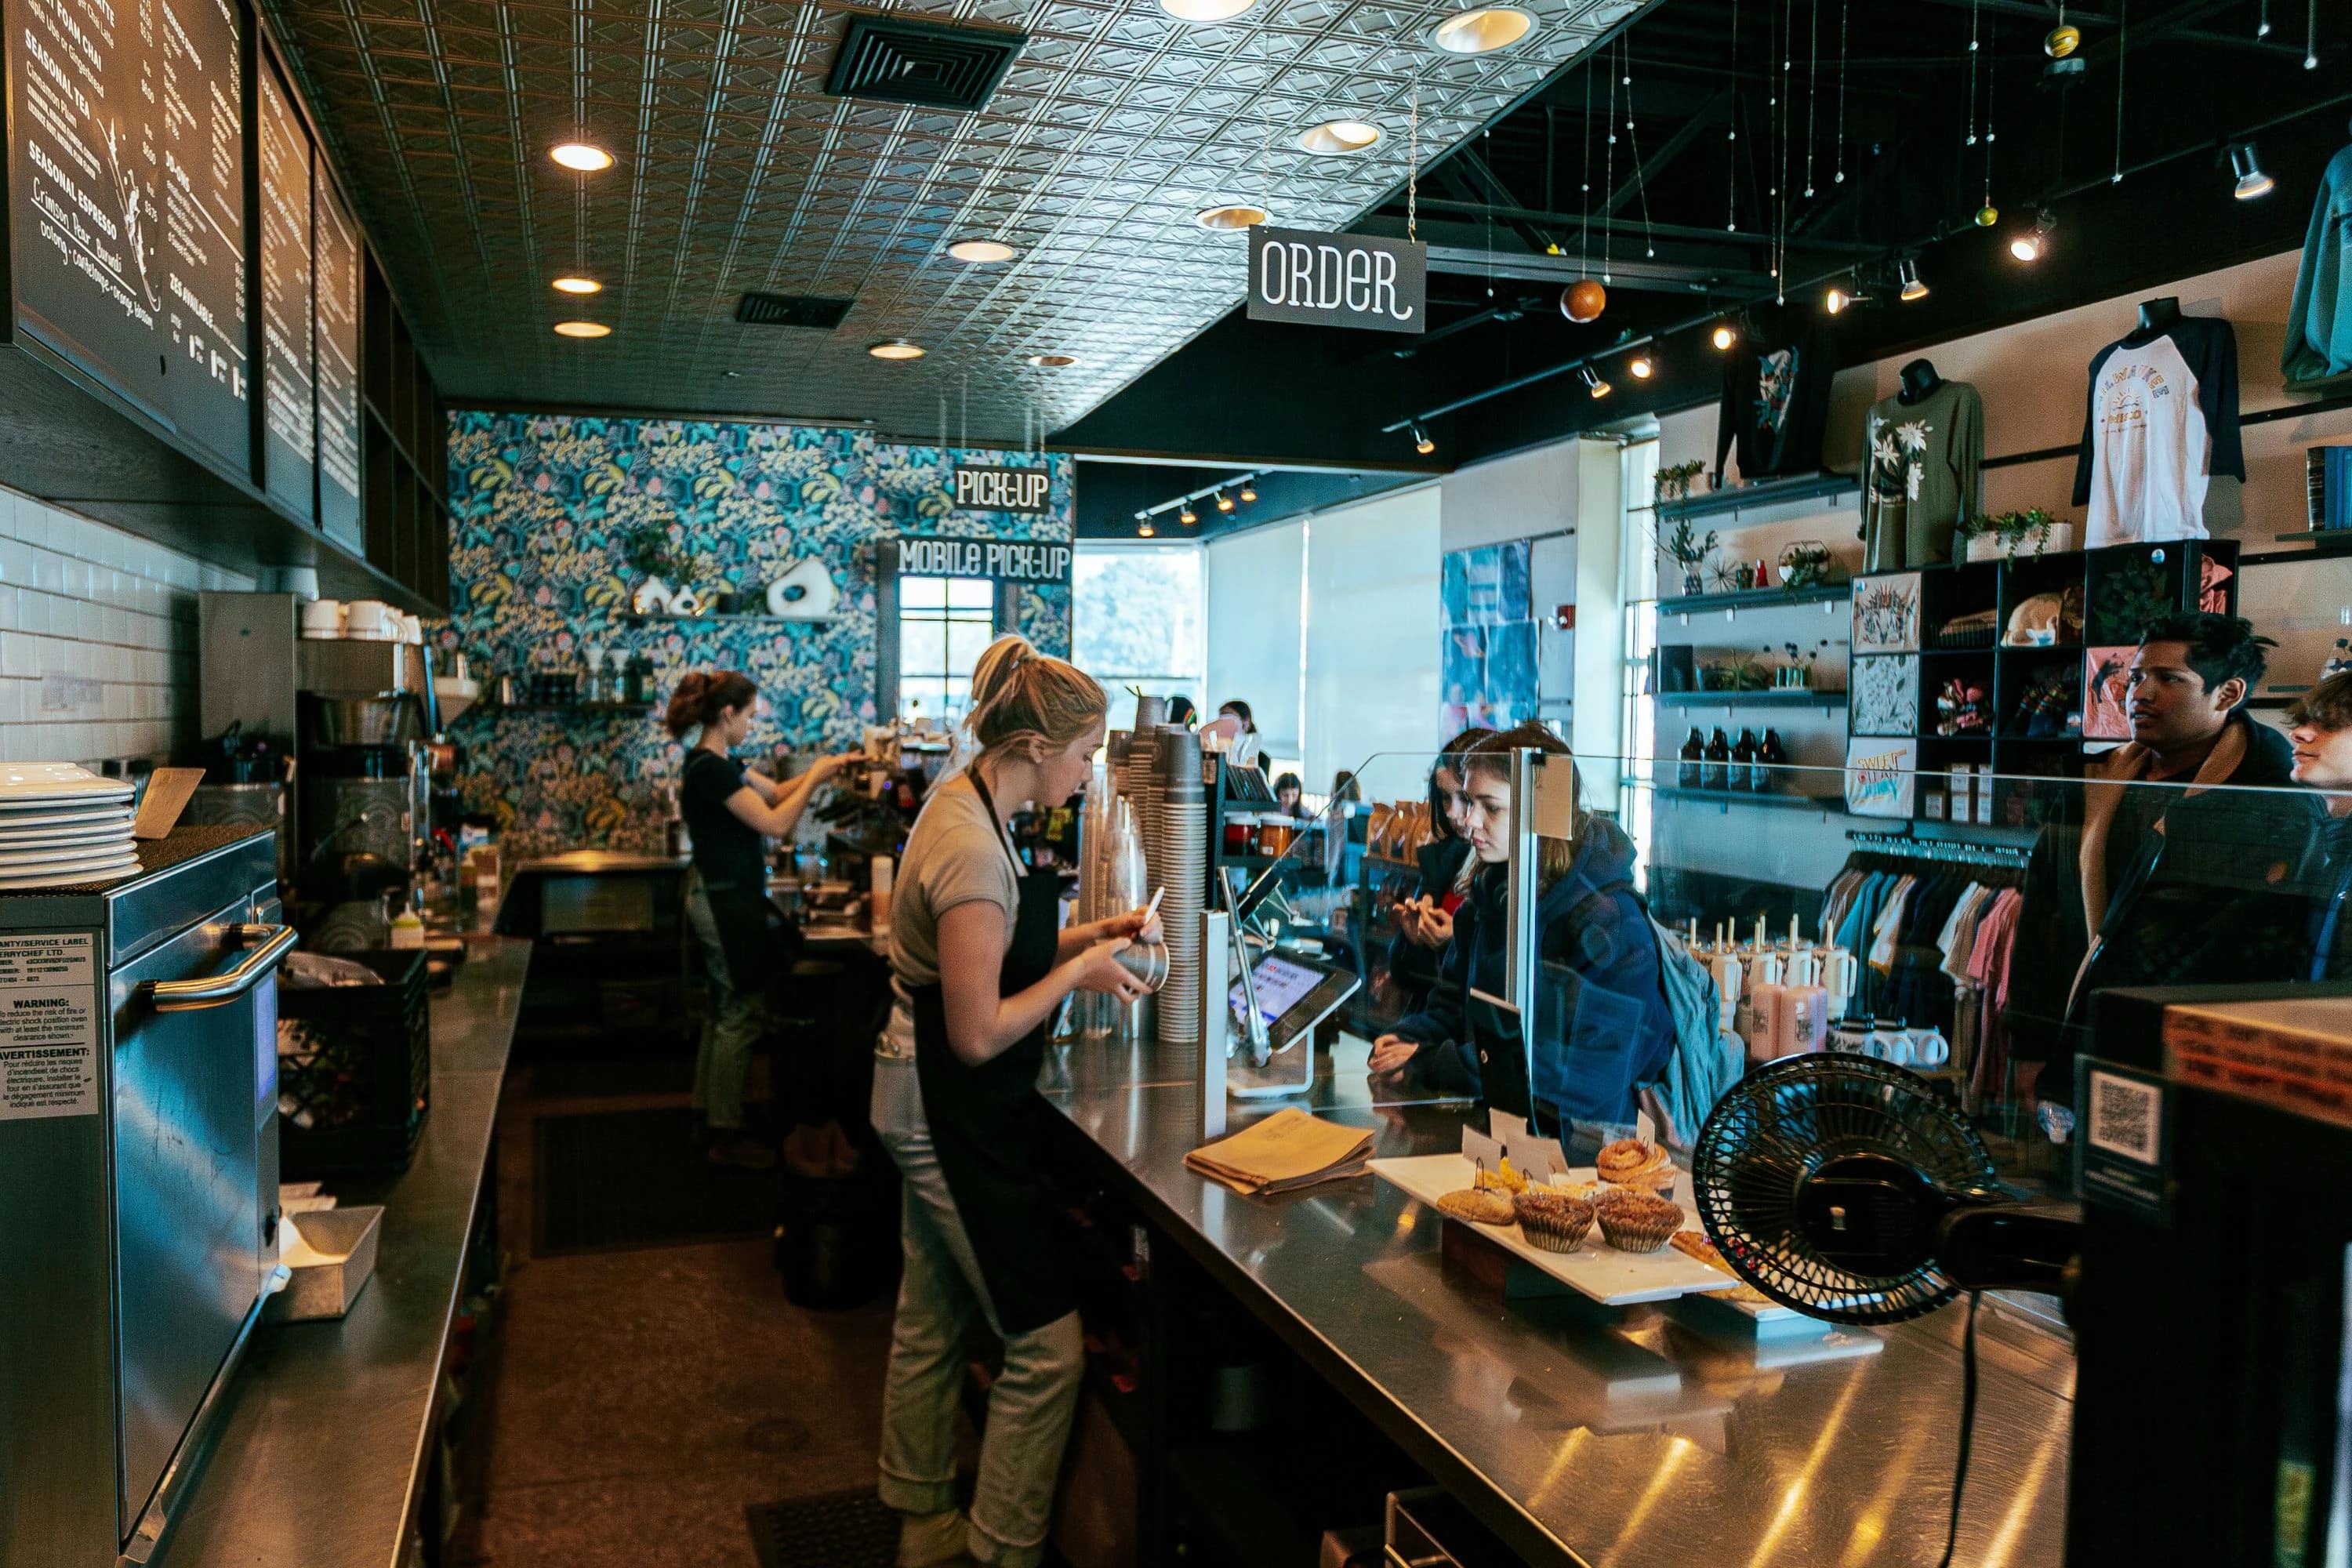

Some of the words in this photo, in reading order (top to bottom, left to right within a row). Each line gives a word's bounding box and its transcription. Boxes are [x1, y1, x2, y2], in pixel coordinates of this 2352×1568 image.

[56, 0, 81, 45] FOAM
[82, 34, 102, 72] CHAI
[25, 27, 74, 100] SEASONAL
[74, 86, 91, 120] TEA
[27, 60, 60, 110] Cinnamon
[60, 99, 78, 129] Plum
[68, 44, 104, 99] Gingerbread
[29, 140, 77, 202] SEASONAL
[78, 189, 117, 240] ESPRESSO
[33, 176, 70, 230] Crimson
[956, 470, 1049, 507] PICK-UP
[985, 544, 1071, 579] PICK-UP
[13, 998, 69, 1009] WARNING:
